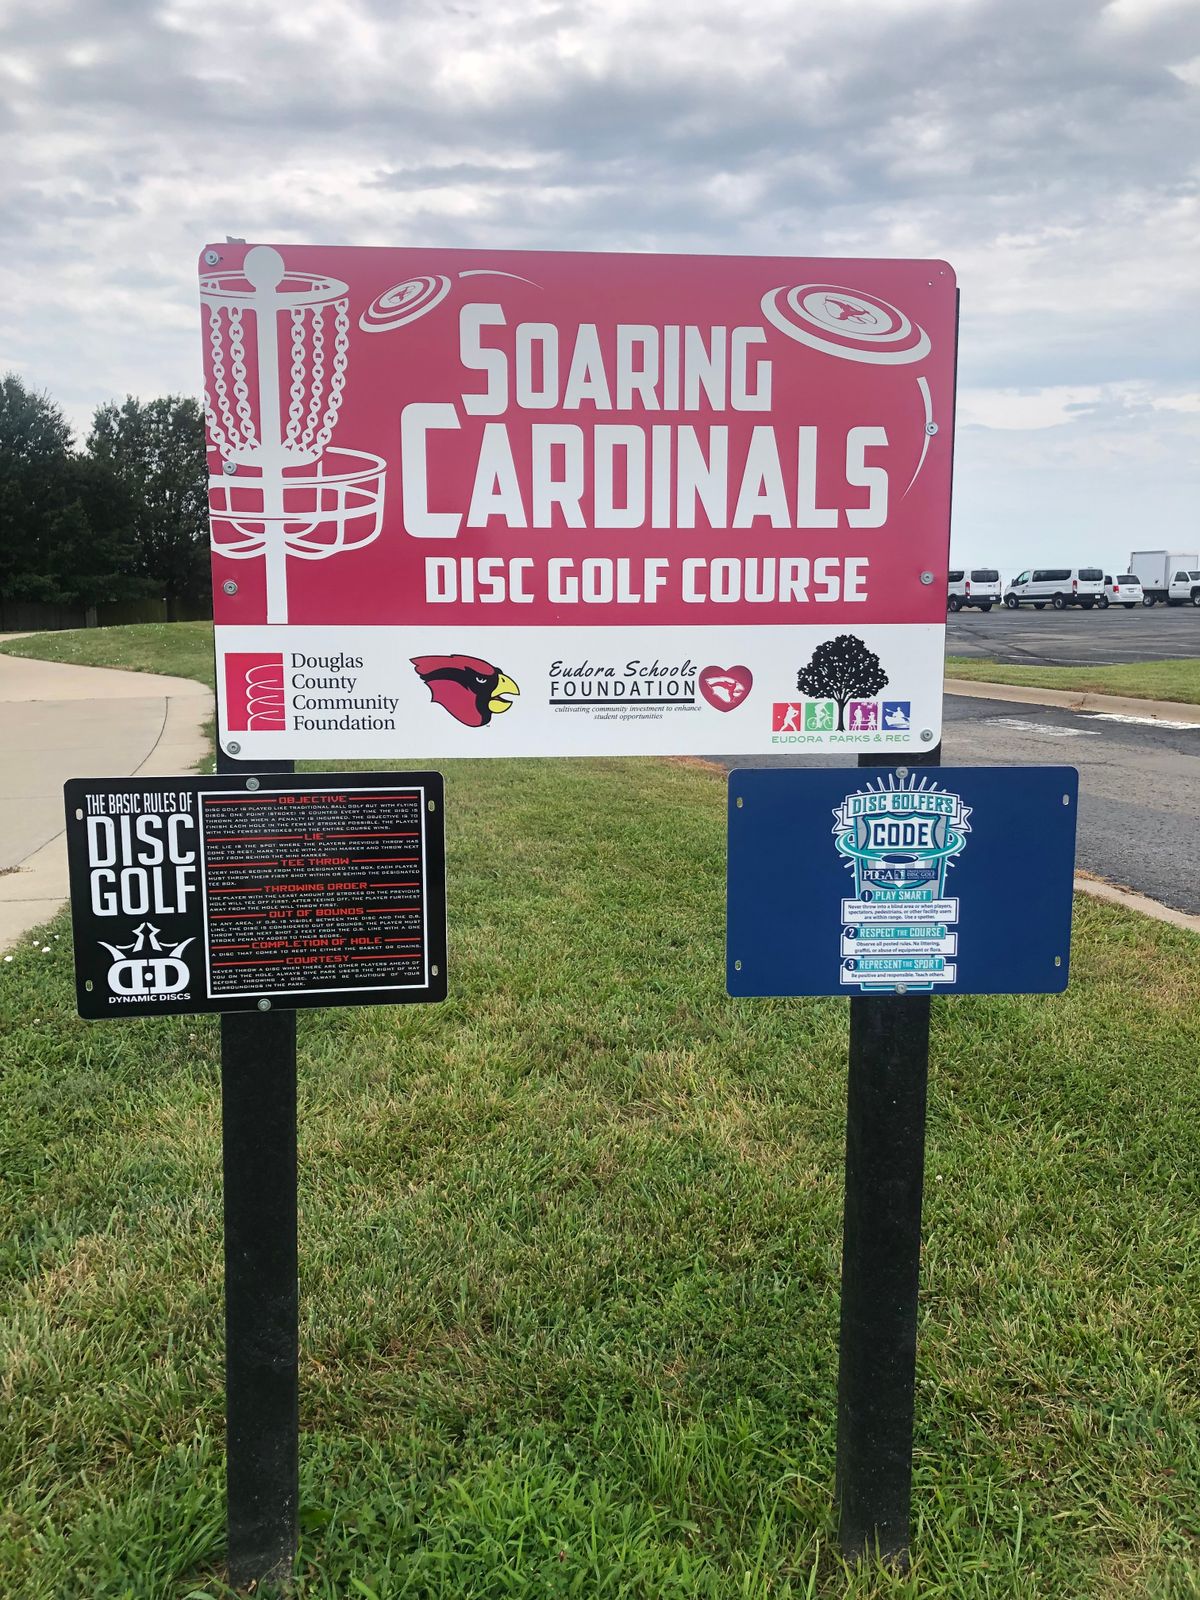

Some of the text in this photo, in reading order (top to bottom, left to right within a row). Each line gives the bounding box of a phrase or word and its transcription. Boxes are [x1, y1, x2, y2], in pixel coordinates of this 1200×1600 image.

[459, 303, 773, 416] SOARING
[400, 402, 889, 539] CARDINALS
[425, 557, 869, 604] DISC GOLF COURSE
[291, 652, 364, 672] Douglas
[549, 660, 697, 677] Eudora Schools
[292, 674, 357, 693] County
[551, 680, 695, 696] FOUNDATION
[293, 695, 399, 713] Community
[293, 715, 396, 730] Foundation
[619, 713, 662, 721] opportunities
[86, 792, 192, 814] THE BASIC RULES OF
[279, 796, 346, 804] OBJECTIVE
[853, 795, 886, 814] DISC
[87, 814, 195, 867] DISC
[874, 824, 928, 846] CODE
[863, 870, 893, 880] PDGA
[90, 866, 196, 916] GOLF
[264, 884, 324, 892] THROWING
[876, 891, 896, 900] PLAY
[899, 891, 927, 900] SMART
[316, 908, 363, 916] BOUNDS
[849, 928, 854, 938] 2
[860, 928, 895, 937] RESPECT
[909, 928, 941, 937] COURSE
[252, 940, 328, 948] COMPLETION
[286, 955, 349, 964] COURTESY
[849, 960, 854, 969] 3
[860, 960, 902, 969] REPRESENT
[914, 960, 939, 969] SPORT
[109, 995, 157, 1003] DYNAMIC
